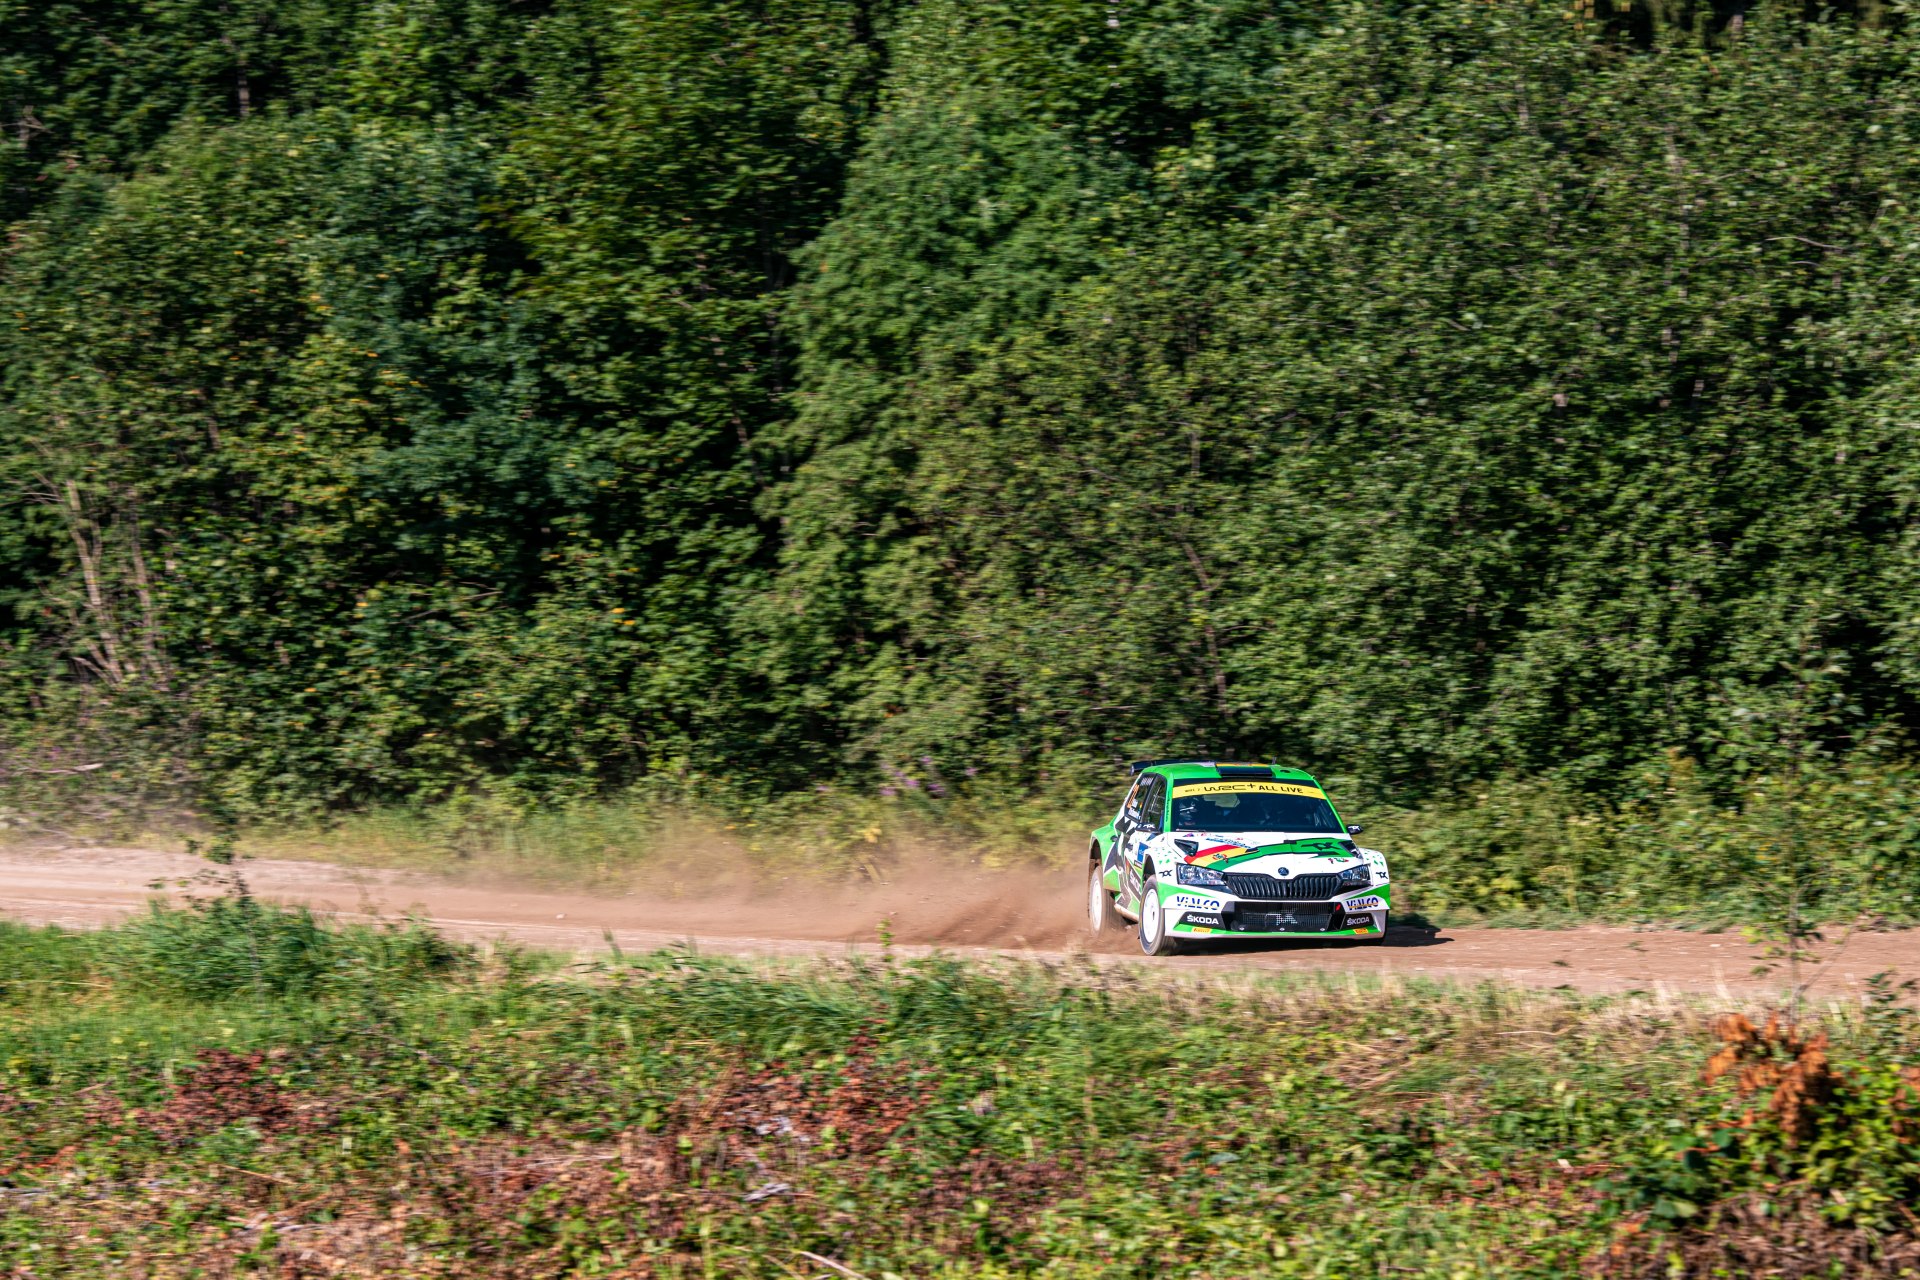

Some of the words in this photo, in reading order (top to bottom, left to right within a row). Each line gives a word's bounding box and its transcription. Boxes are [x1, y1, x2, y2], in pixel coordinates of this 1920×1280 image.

[1280, 786, 1304, 794] LIVE
[1186, 914, 1219, 925] ŠKODA
[1346, 916, 1370, 926] ŠKODA
